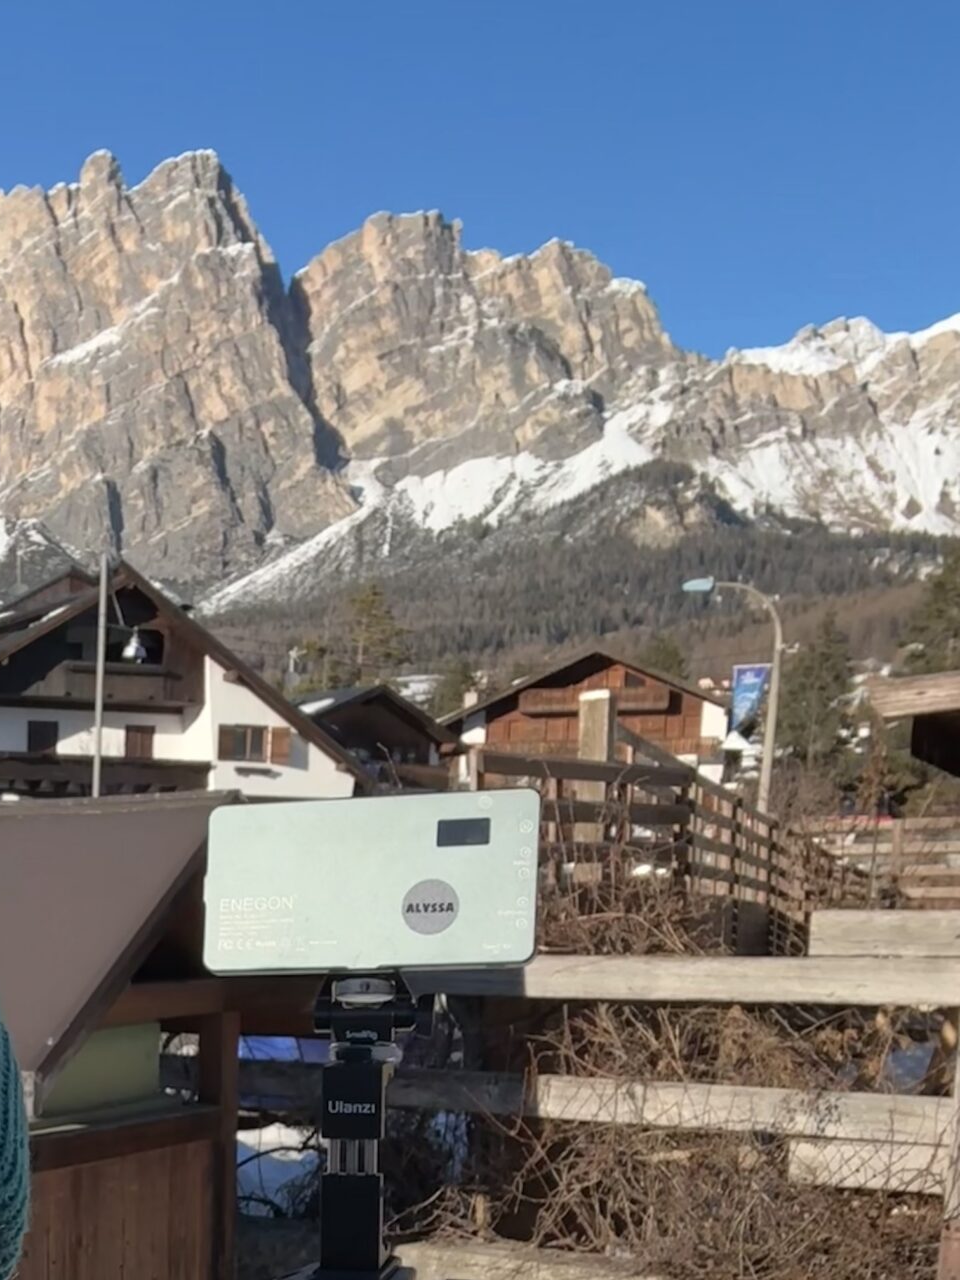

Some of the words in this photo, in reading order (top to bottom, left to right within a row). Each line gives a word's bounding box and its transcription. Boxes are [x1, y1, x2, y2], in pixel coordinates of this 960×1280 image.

[219, 895, 294, 912] ENEGON
[406, 902, 454, 914] ALYSSA
[328, 1099, 376, 1114] Ulanzi
